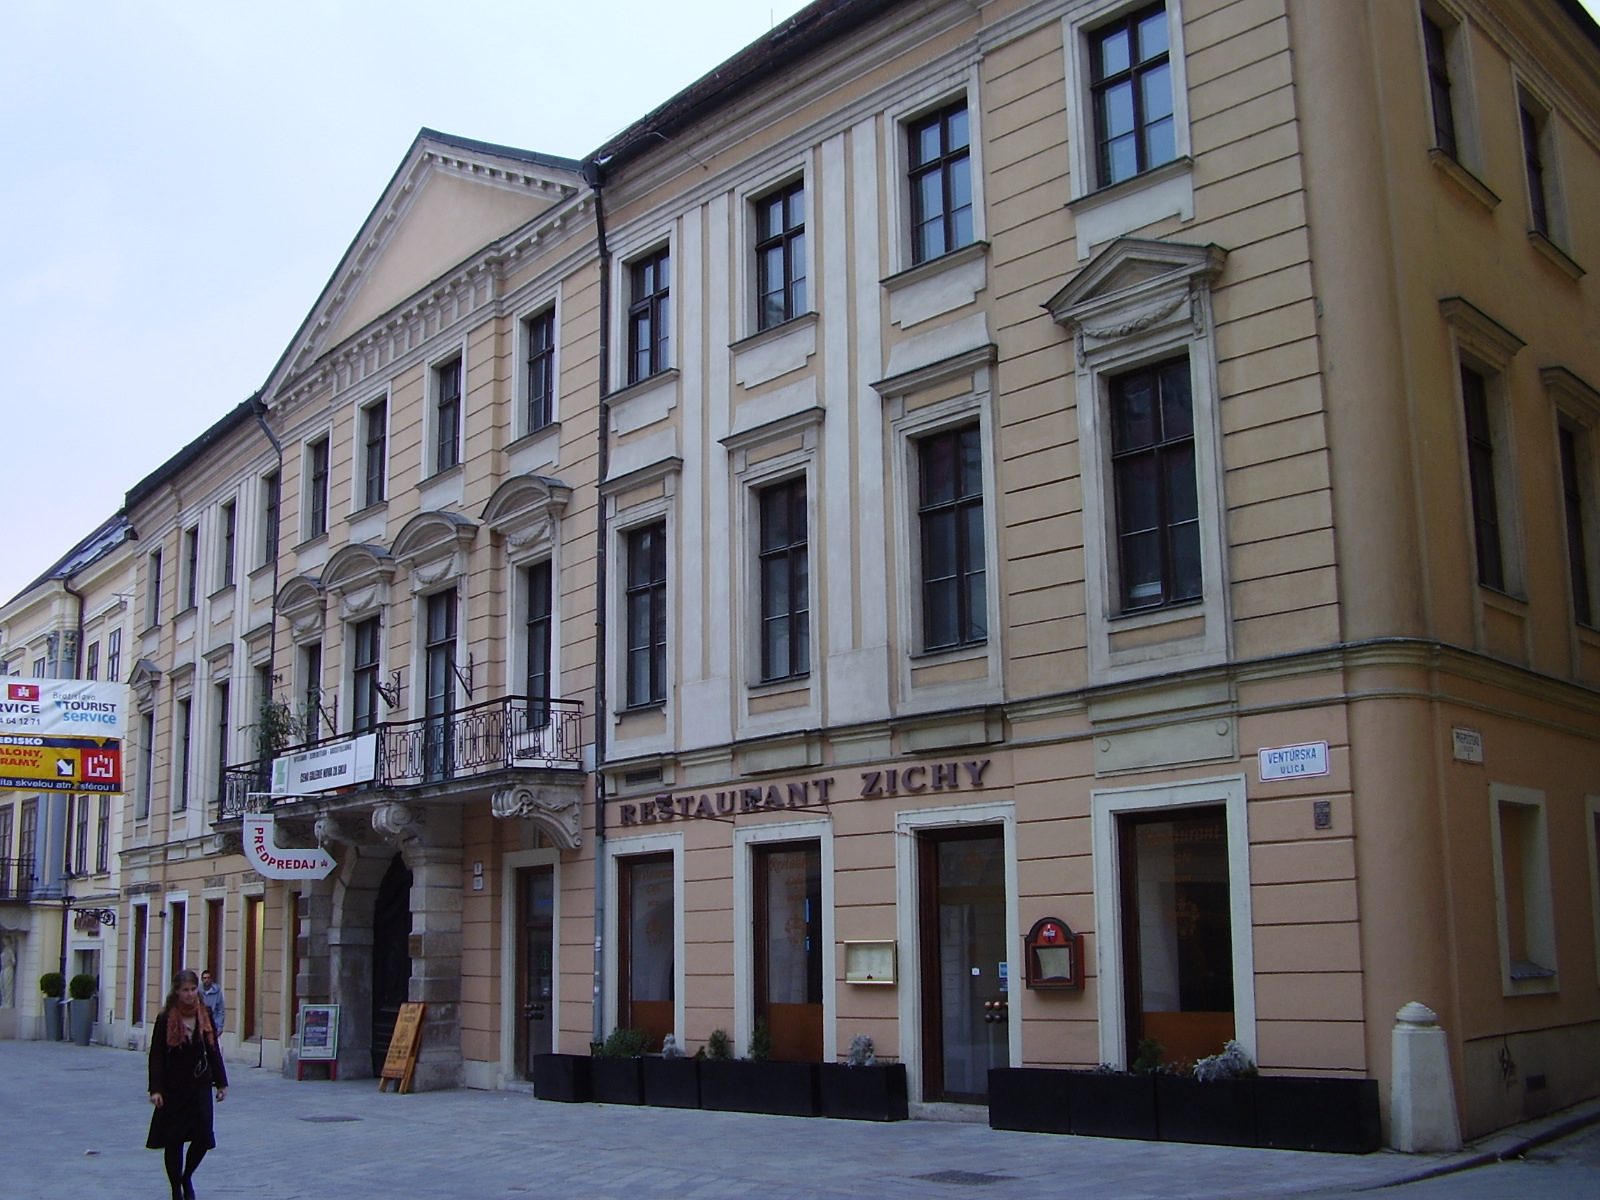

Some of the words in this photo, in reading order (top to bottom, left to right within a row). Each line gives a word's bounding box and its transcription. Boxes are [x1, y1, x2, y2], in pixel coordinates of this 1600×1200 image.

[63, 701, 117, 712] TOURIST
[31, 718, 41, 726] 71
[1267, 747, 1317, 764] VENTÚRSKA
[1280, 764, 1306, 774] ULICA
[860, 759, 991, 797] ZICHY
[254, 827, 316, 870] PREDPREDAJ
